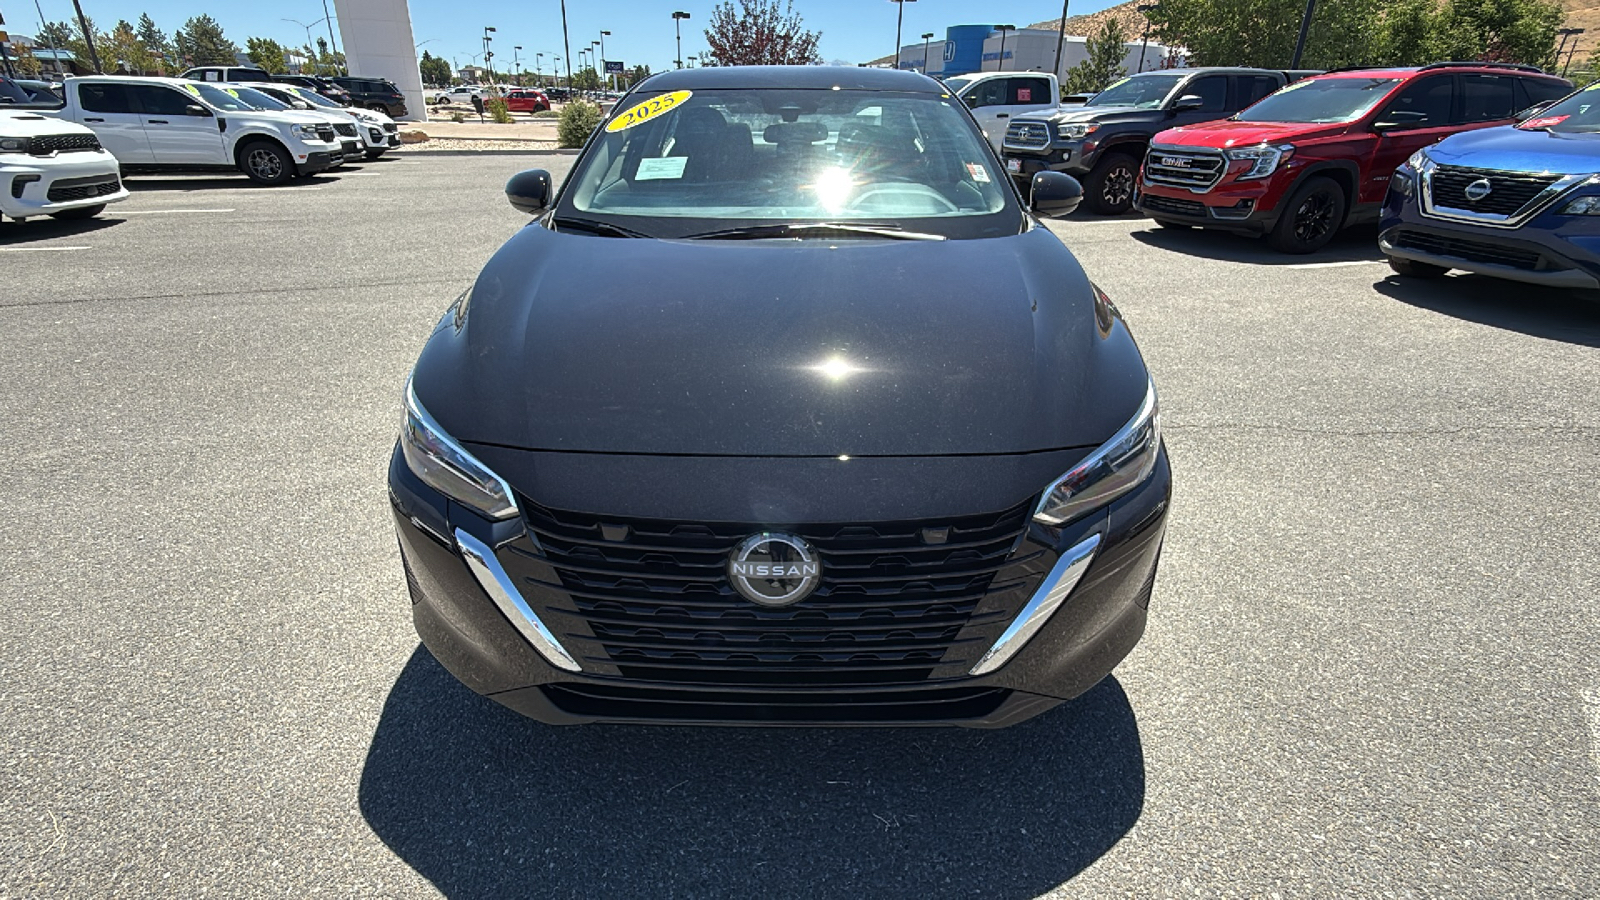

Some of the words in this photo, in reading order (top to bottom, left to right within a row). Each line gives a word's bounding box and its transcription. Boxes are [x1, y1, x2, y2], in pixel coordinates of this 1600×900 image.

[623, 95, 674, 127] 2025
[1161, 157, 1192, 168] GMC
[733, 563, 816, 576] NISSAN
